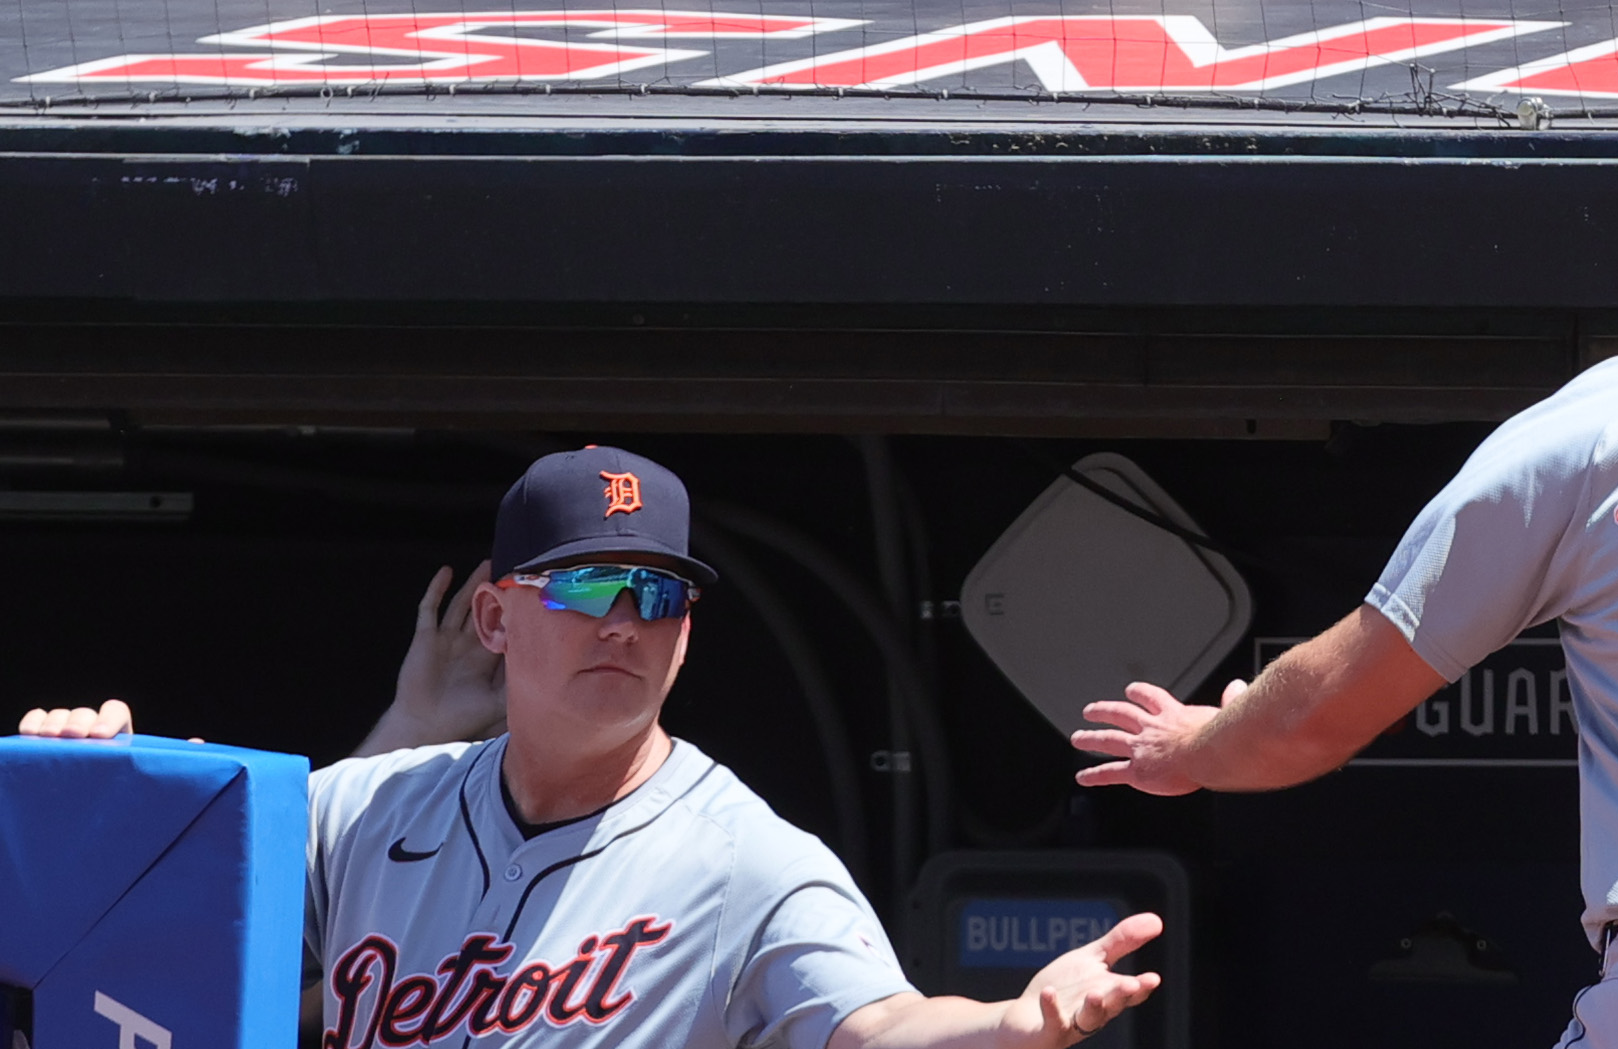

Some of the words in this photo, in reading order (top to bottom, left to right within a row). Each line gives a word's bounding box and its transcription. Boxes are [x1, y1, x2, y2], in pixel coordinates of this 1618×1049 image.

[600, 470, 643, 518] D
[1415, 667, 1578, 737] GUAR
[966, 916, 1110, 951] BULLPEN
